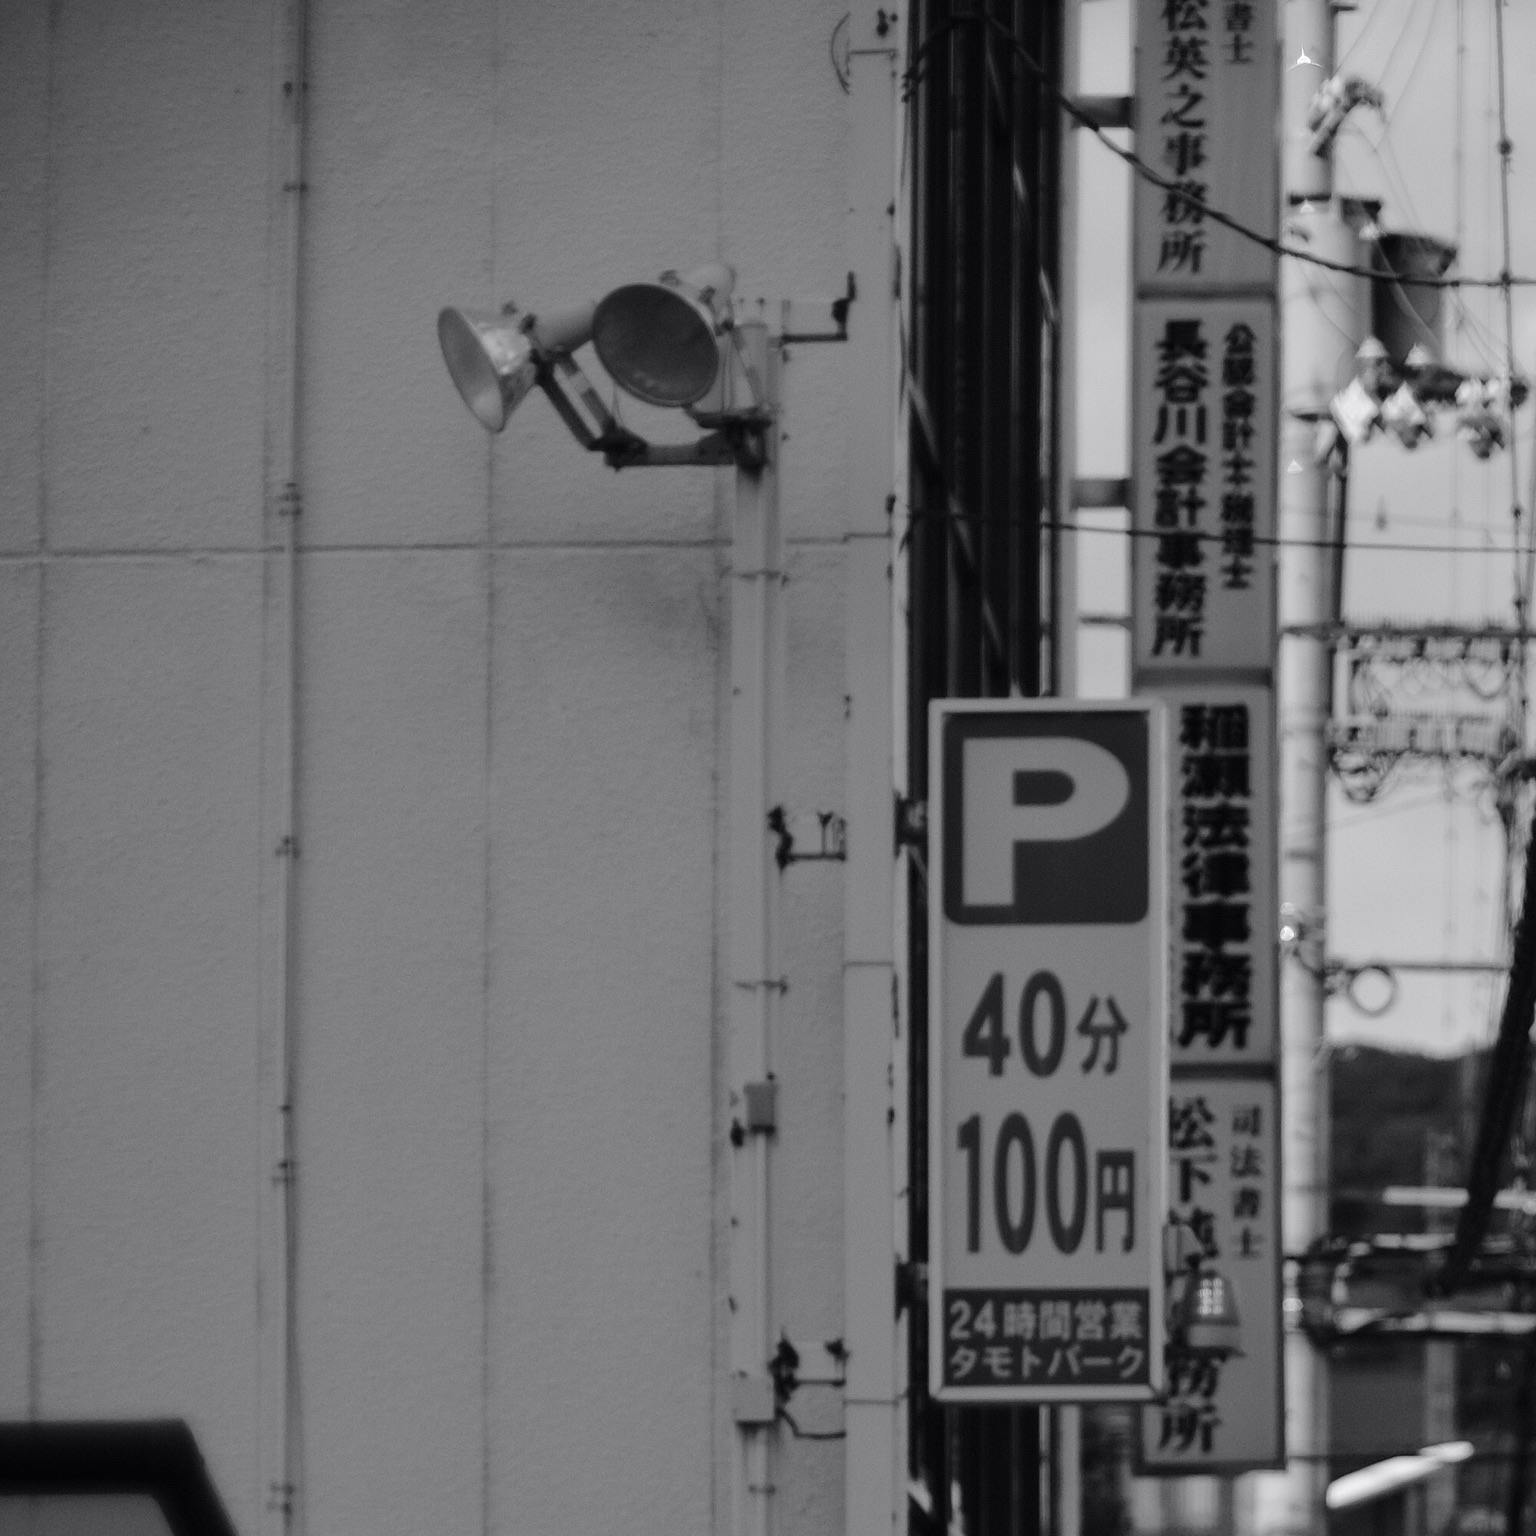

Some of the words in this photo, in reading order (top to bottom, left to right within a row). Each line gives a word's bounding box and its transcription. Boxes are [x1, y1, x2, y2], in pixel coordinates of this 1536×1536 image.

[1152, 318, 1208, 657] 長谷川会計事務所
[961, 735, 1133, 909] P
[961, 969, 1129, 1079] 40分
[957, 1110, 1137, 1257] 100円
[1229, 1104, 1264, 1260] 司法書士
[948, 1298, 1144, 1342] 24時間営業
